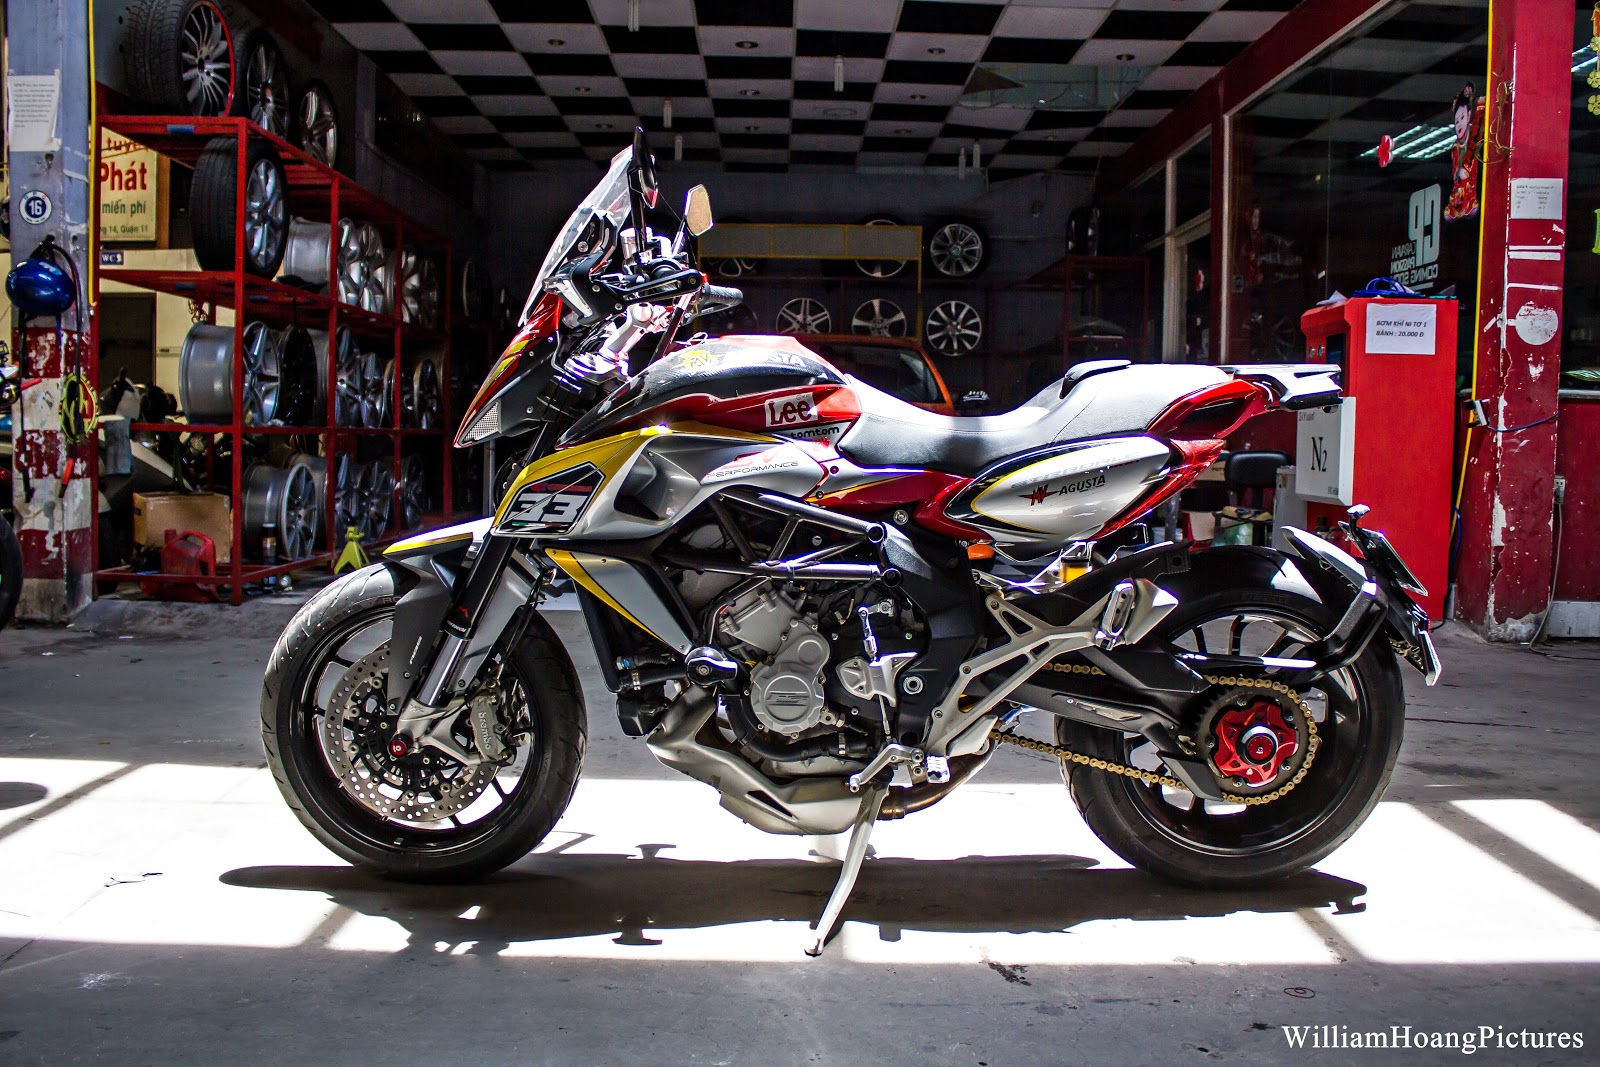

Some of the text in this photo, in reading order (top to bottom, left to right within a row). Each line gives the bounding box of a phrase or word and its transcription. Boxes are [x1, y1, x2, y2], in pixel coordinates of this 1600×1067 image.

[29, 200, 42, 216] 16
[102, 253, 116, 263] WC
[768, 400, 812, 425] Lee
[790, 426, 840, 439] tomtom
[1058, 474, 1106, 496] AGUSTA
[478, 711, 492, 750] brembo
